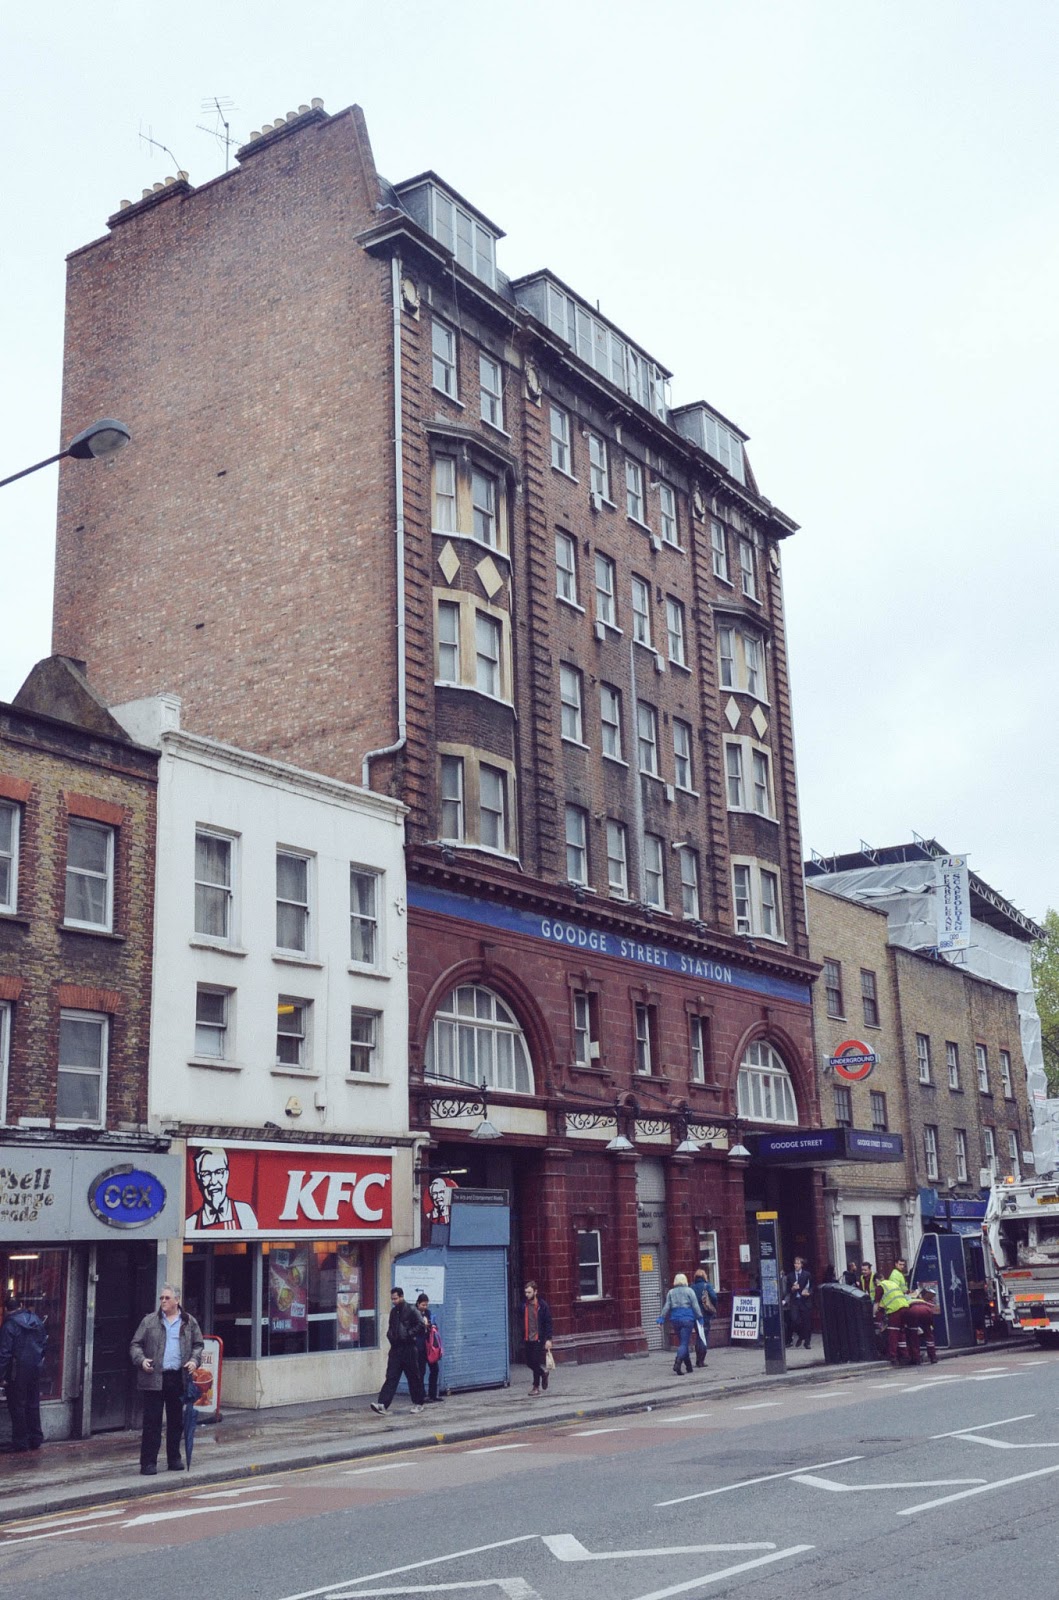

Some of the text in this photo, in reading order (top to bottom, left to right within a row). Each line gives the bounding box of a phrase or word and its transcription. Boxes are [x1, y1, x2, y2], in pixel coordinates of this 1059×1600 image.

[541, 919, 732, 983] GOODGE STREET STATION
[830, 1055, 875, 1065] UNDERGROUND
[770, 1139, 823, 1149] GOODGE STREET
[278, 1170, 388, 1222] KFC
[733, 1329, 746, 1337] KEYS
